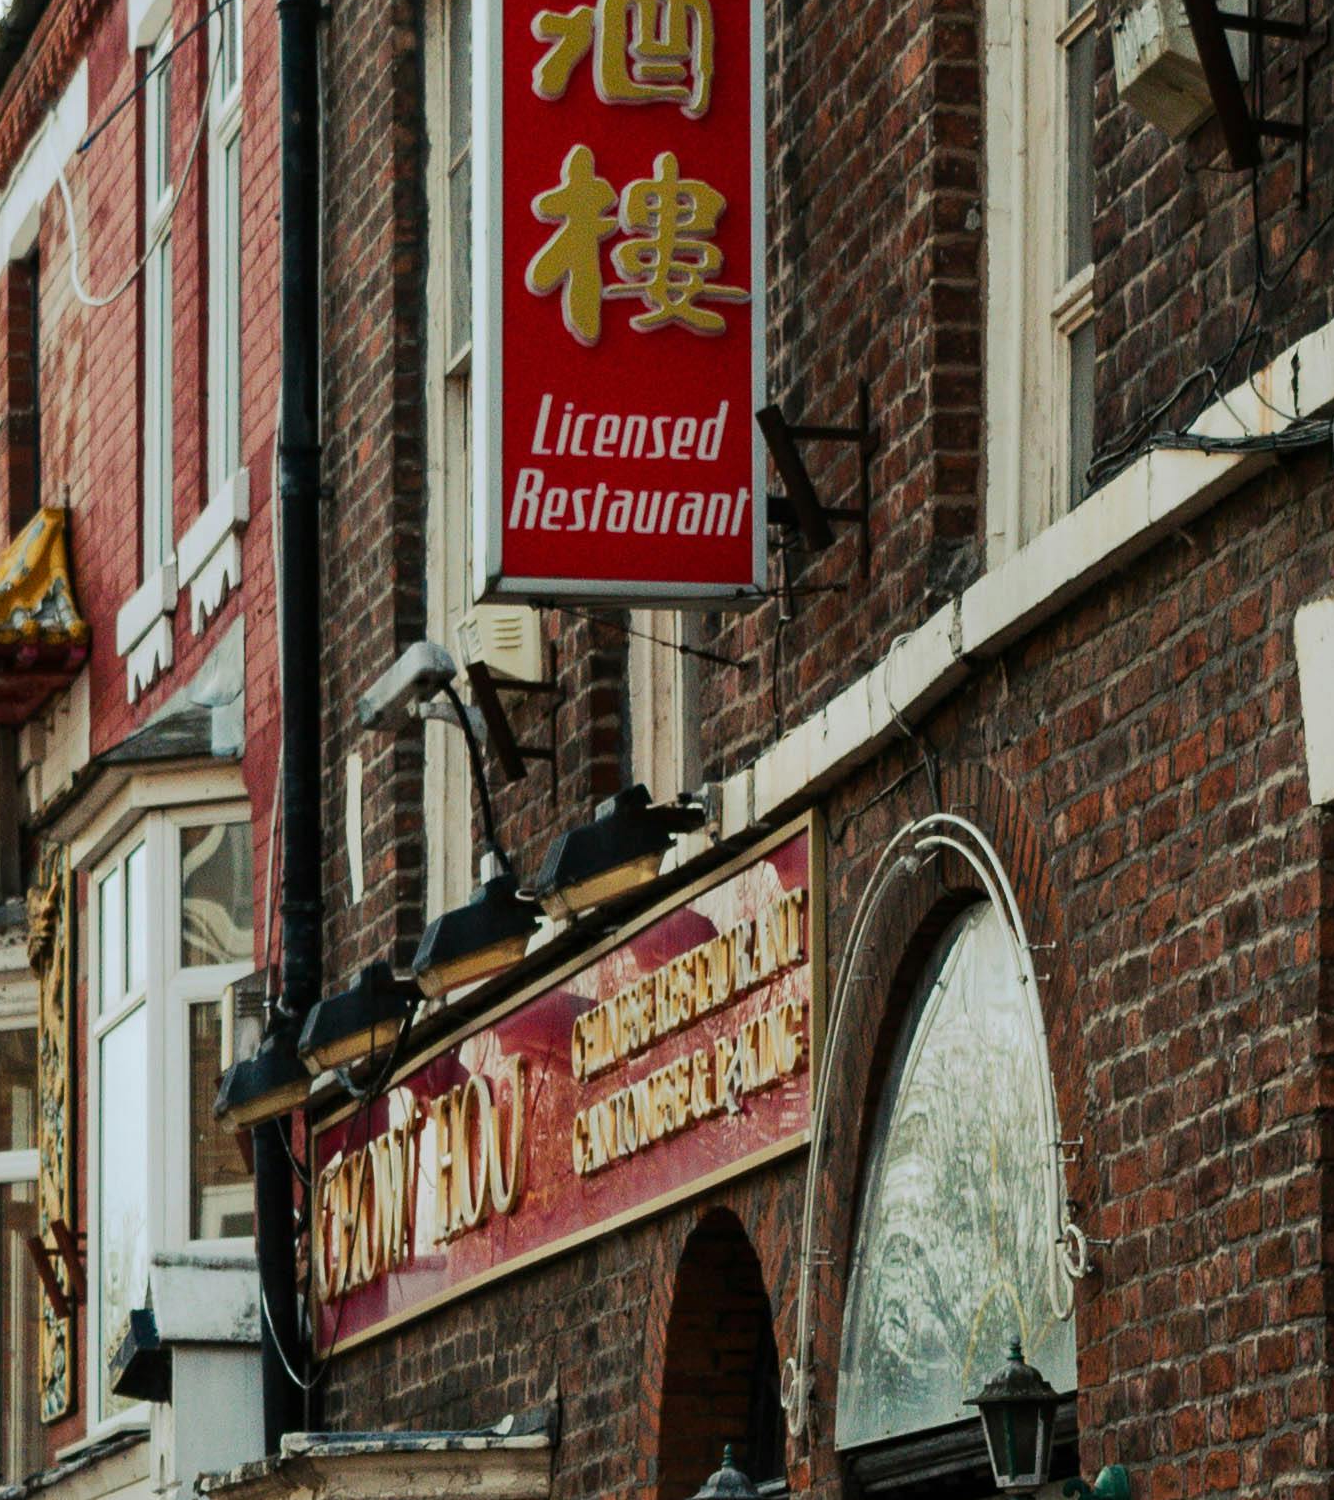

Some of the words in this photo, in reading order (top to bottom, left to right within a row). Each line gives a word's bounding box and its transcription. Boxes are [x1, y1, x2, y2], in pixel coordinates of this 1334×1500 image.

[530, 393, 730, 462] Licensed
[508, 468, 751, 538] Restaurant
[571, 975, 655, 1083] CHINESE
[655, 885, 804, 1037] RESTAURANT
[571, 1056, 692, 1175] CANTONESE
